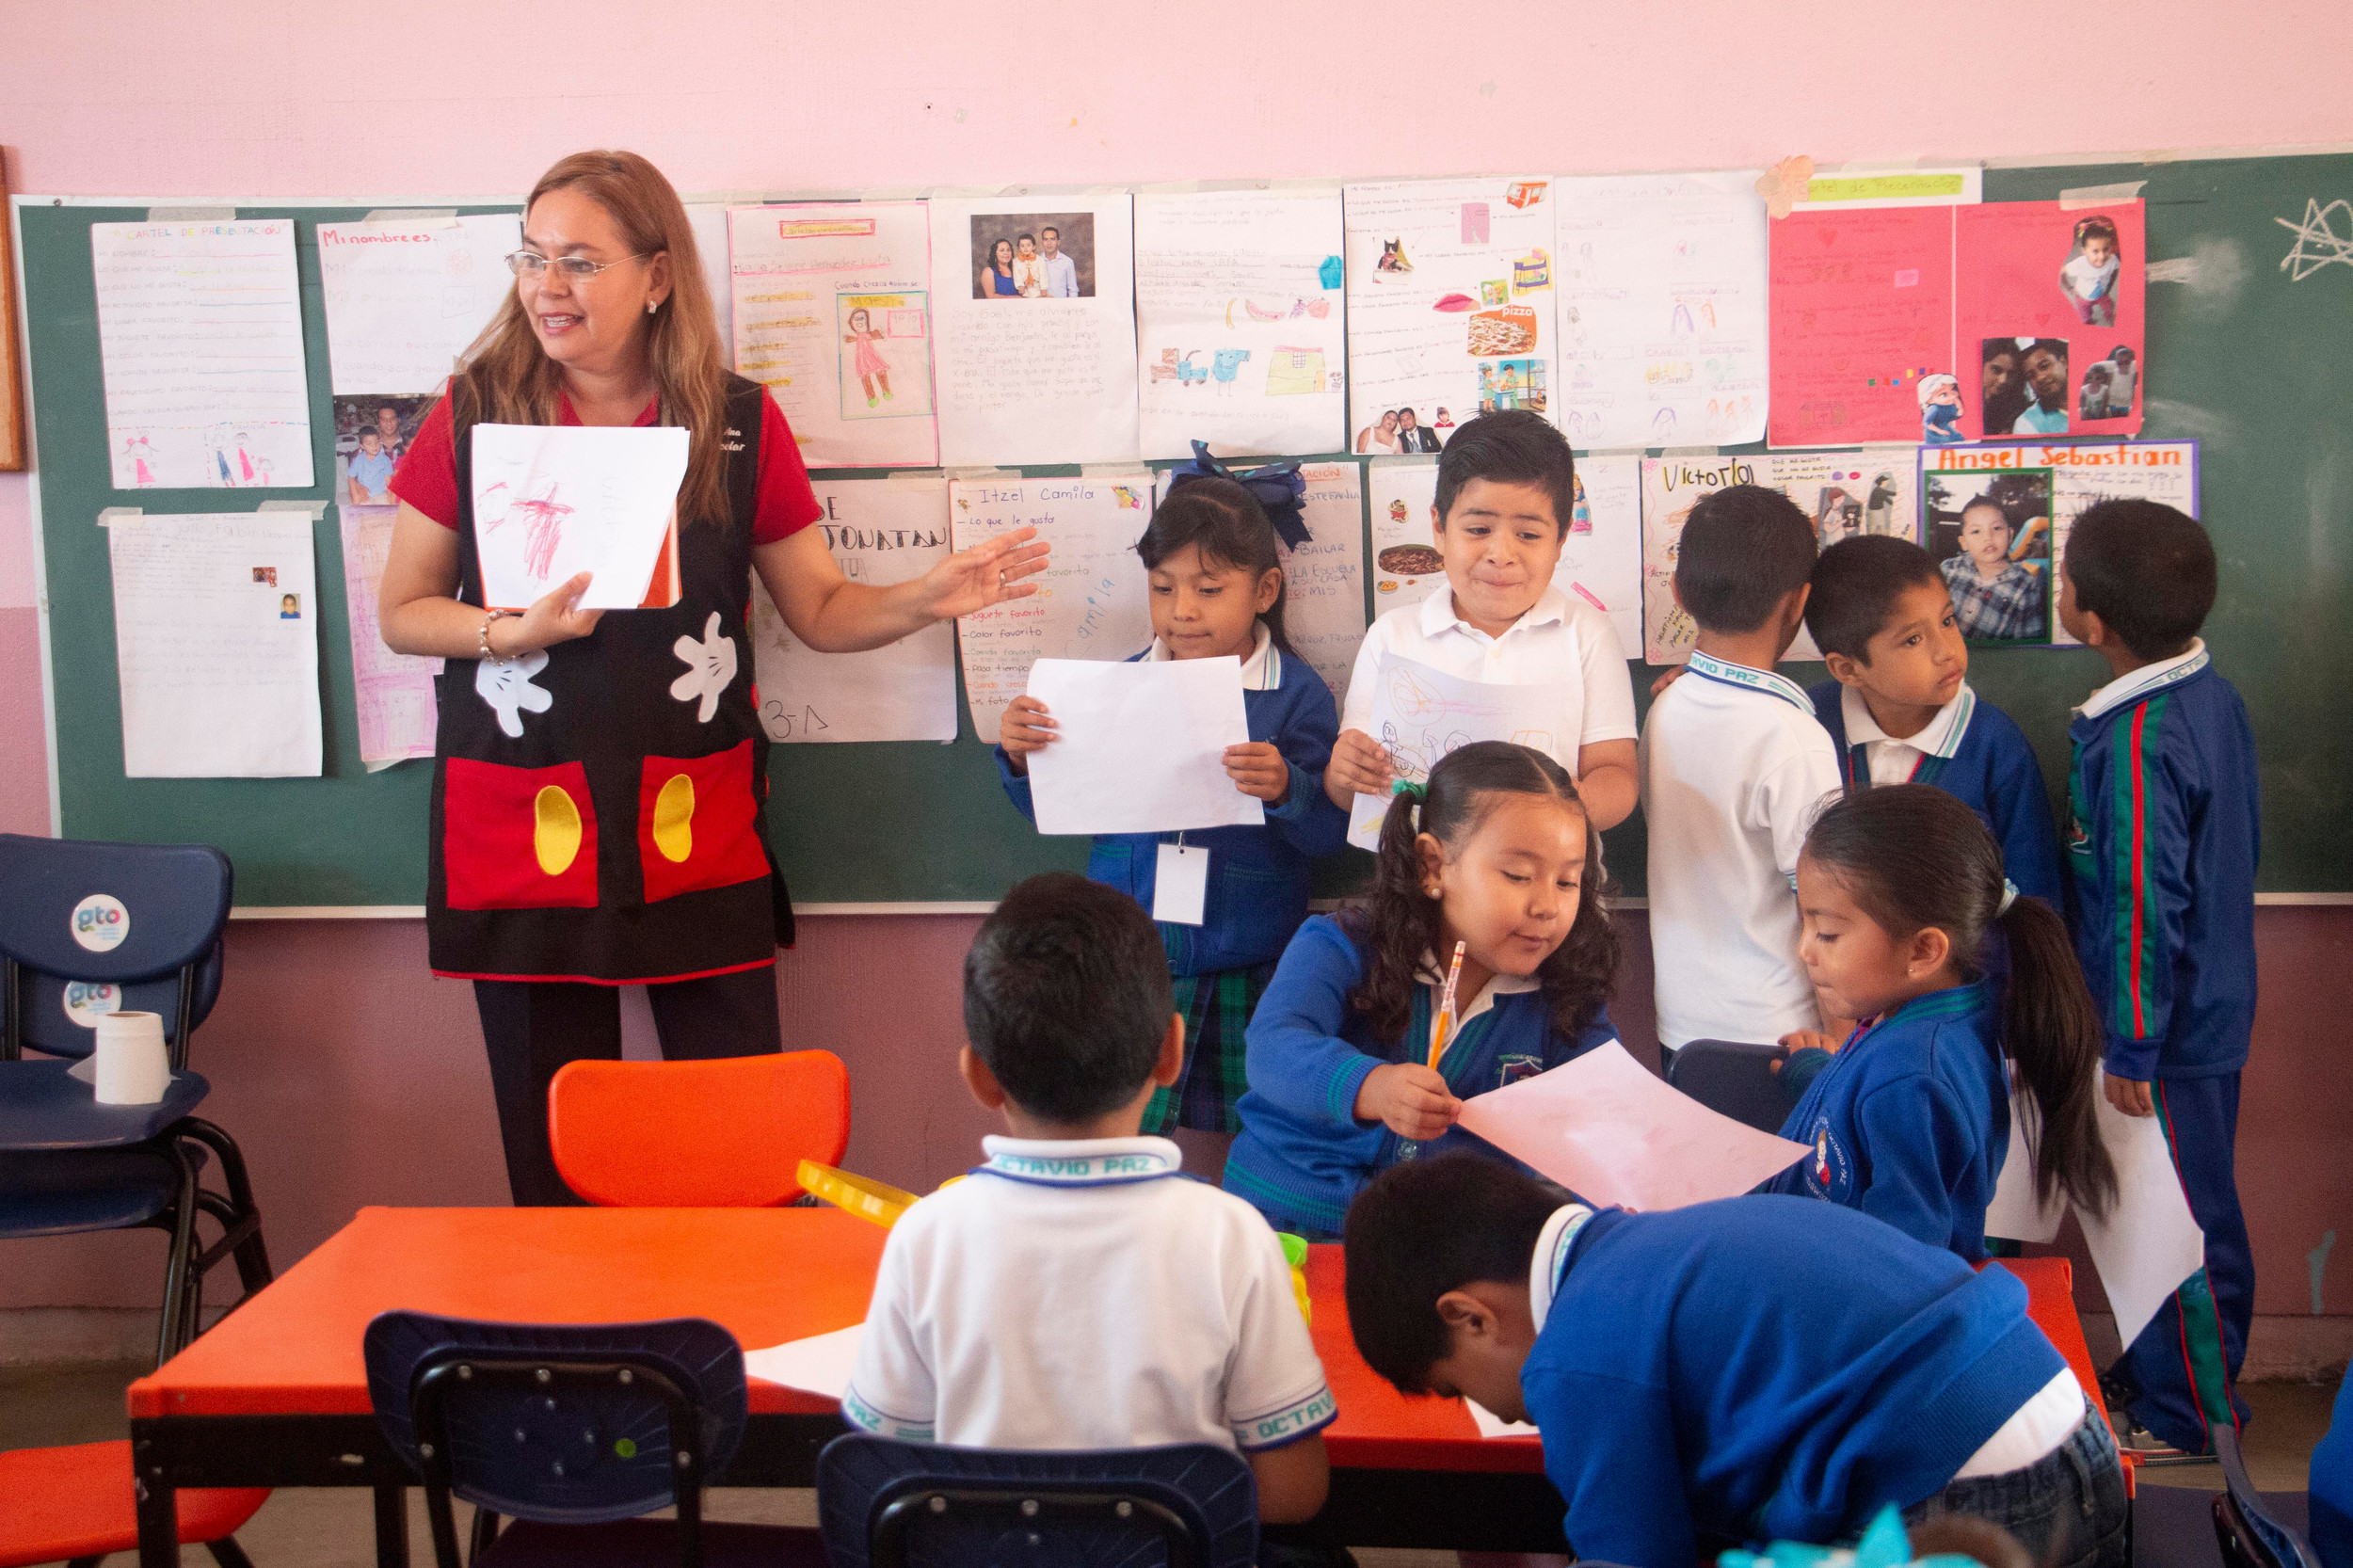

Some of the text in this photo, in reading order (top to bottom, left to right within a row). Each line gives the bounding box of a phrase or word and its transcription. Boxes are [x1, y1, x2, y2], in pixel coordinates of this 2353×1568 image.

[349, 232, 409, 245] nombre
[1502, 305, 1533, 318] pizza
[1938, 447, 2024, 471] Angel
[2040, 446, 2182, 467] Sebastian
[979, 486, 1096, 504] Itzel Camila
[986, 518, 1003, 529] que
[1029, 512, 1055, 528] gusta
[1000, 627, 1042, 637] favorito
[1724, 667, 1760, 684] PAZ
[988, 696, 1009, 706] foto
[77, 905, 120, 932] gto
[1104, 1156, 1150, 1174] PAZ
